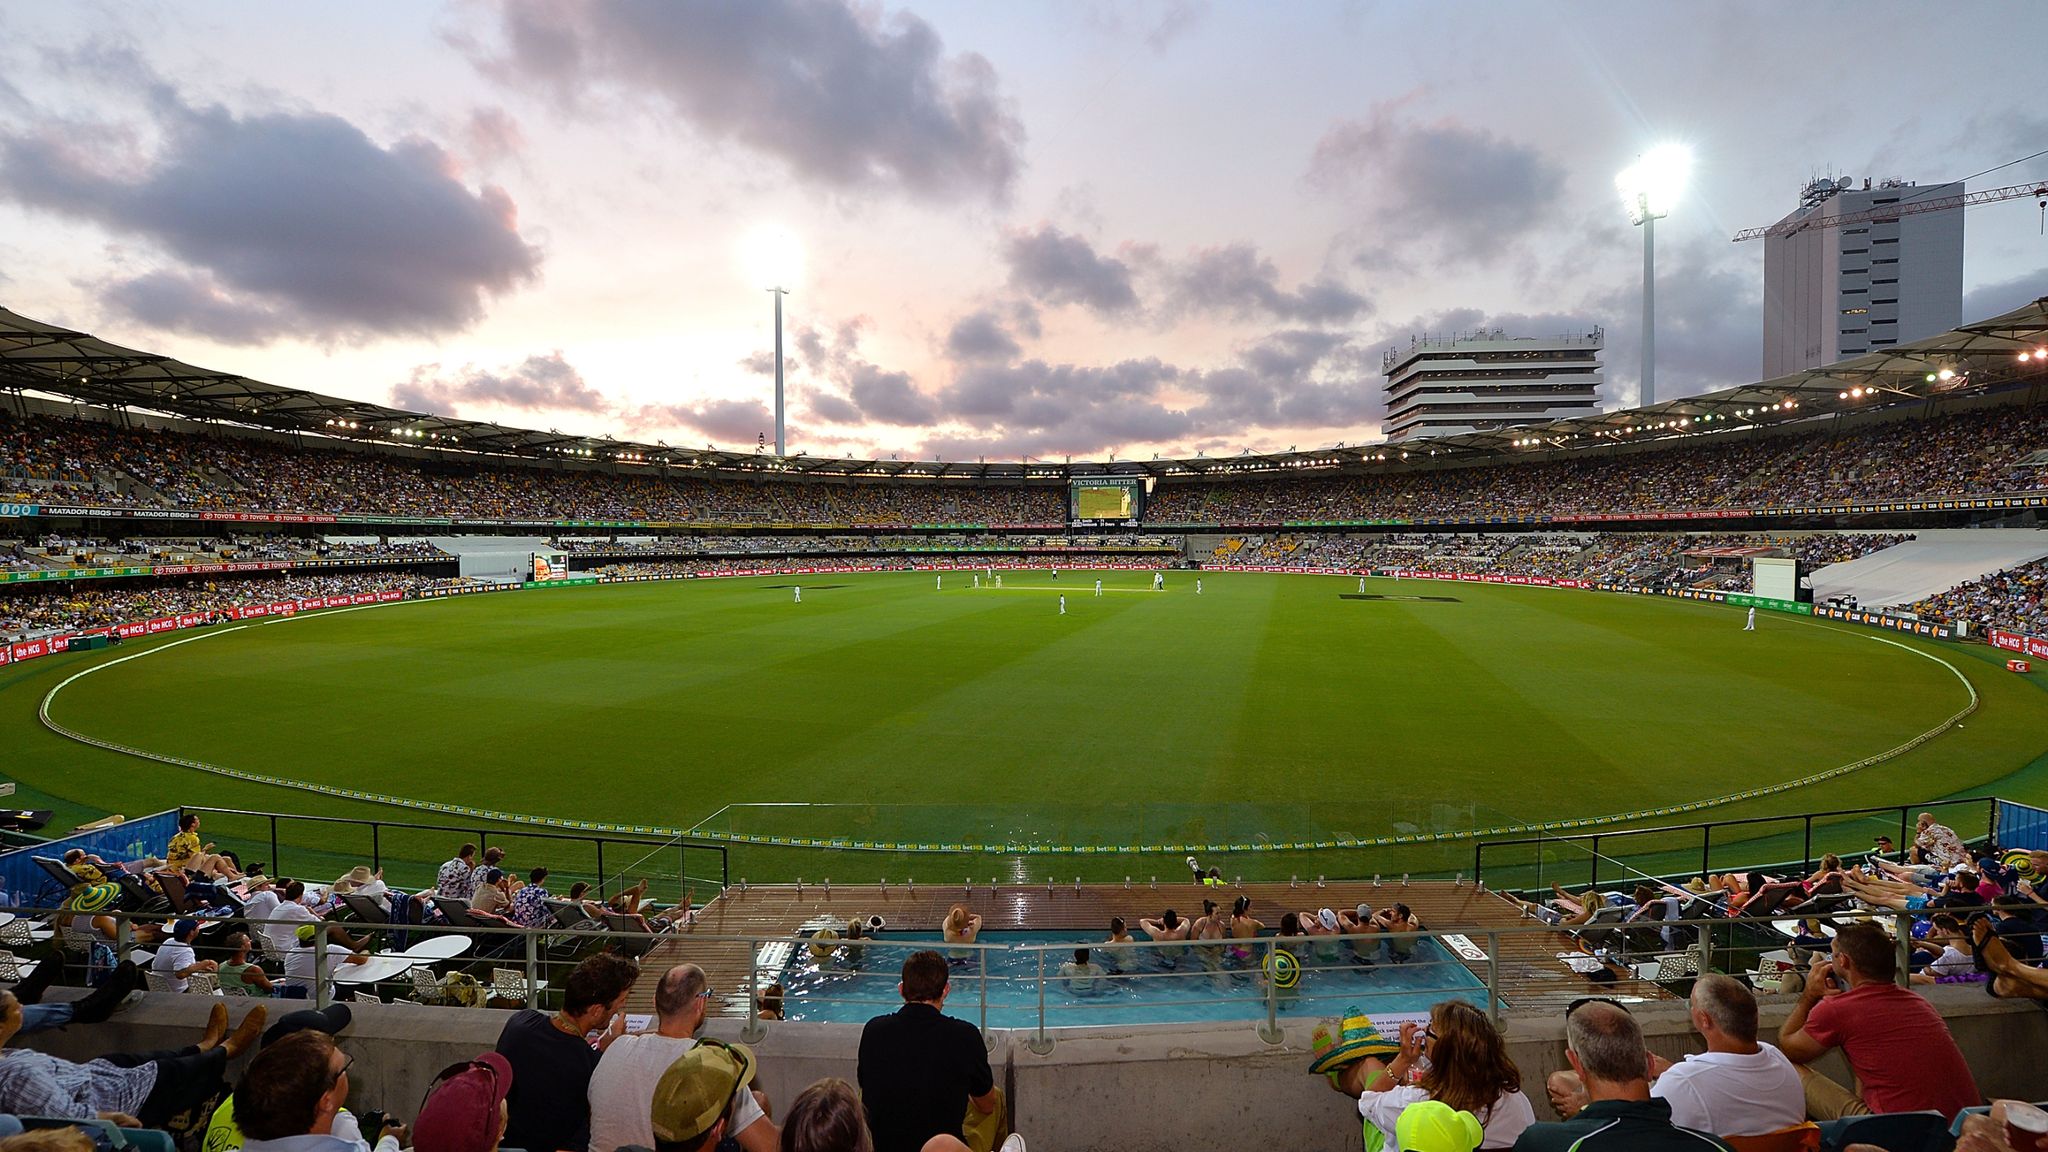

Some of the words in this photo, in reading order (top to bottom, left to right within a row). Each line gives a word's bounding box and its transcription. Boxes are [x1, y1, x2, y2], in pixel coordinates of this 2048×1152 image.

[120, 627, 128, 635] the
[130, 625, 144, 633] HCG
[55, 639, 64, 648] the
[1999, 635, 2008, 645] the
[2008, 637, 2019, 648] HCG
[16, 647, 26, 656] the
[28, 644, 40, 654] HCG
[2032, 642, 2041, 653] the
